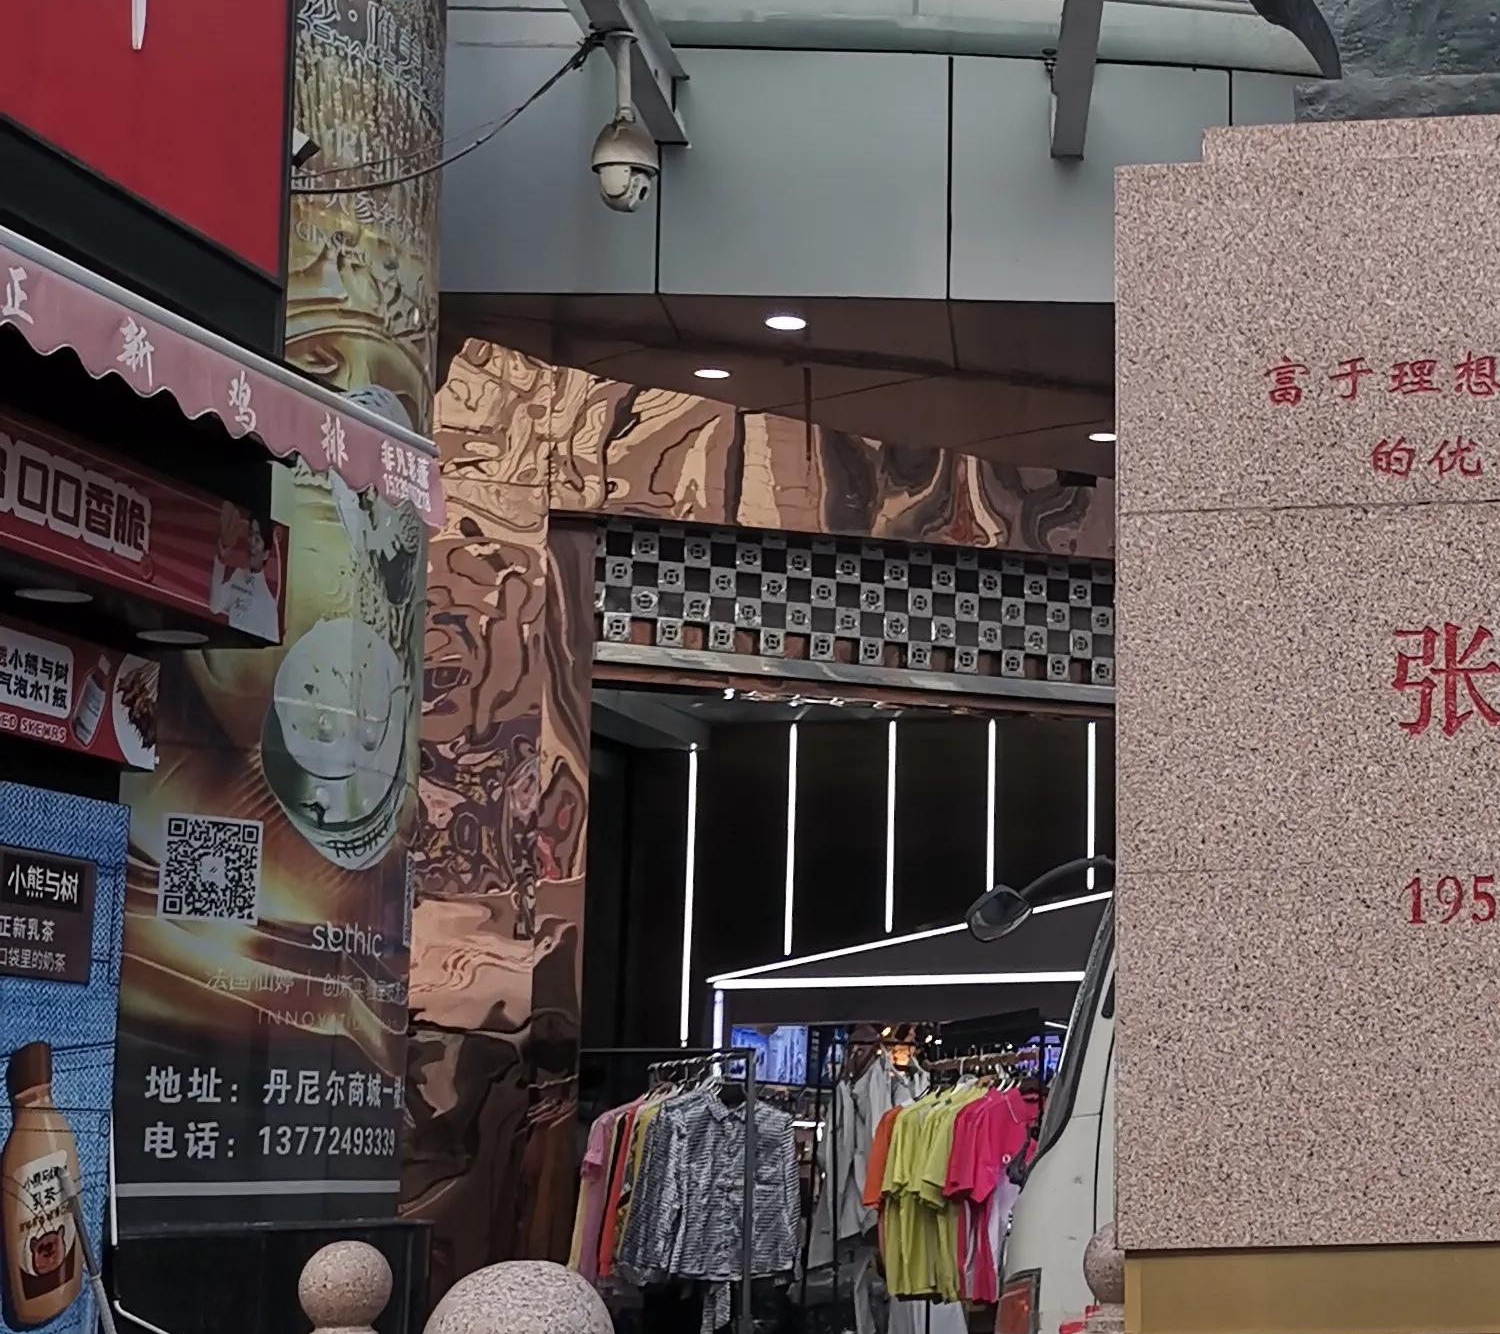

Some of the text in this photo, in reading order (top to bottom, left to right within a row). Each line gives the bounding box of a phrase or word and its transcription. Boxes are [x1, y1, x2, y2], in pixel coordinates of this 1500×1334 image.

[2, 267, 349, 469] 正新鸡排
[7, 863, 79, 905] 小熊与树
[0, 915, 55, 942] 正新乳茶
[144, 1065, 238, 1104] 地址：
[143, 1121, 396, 1160] 电话： 13772493339
